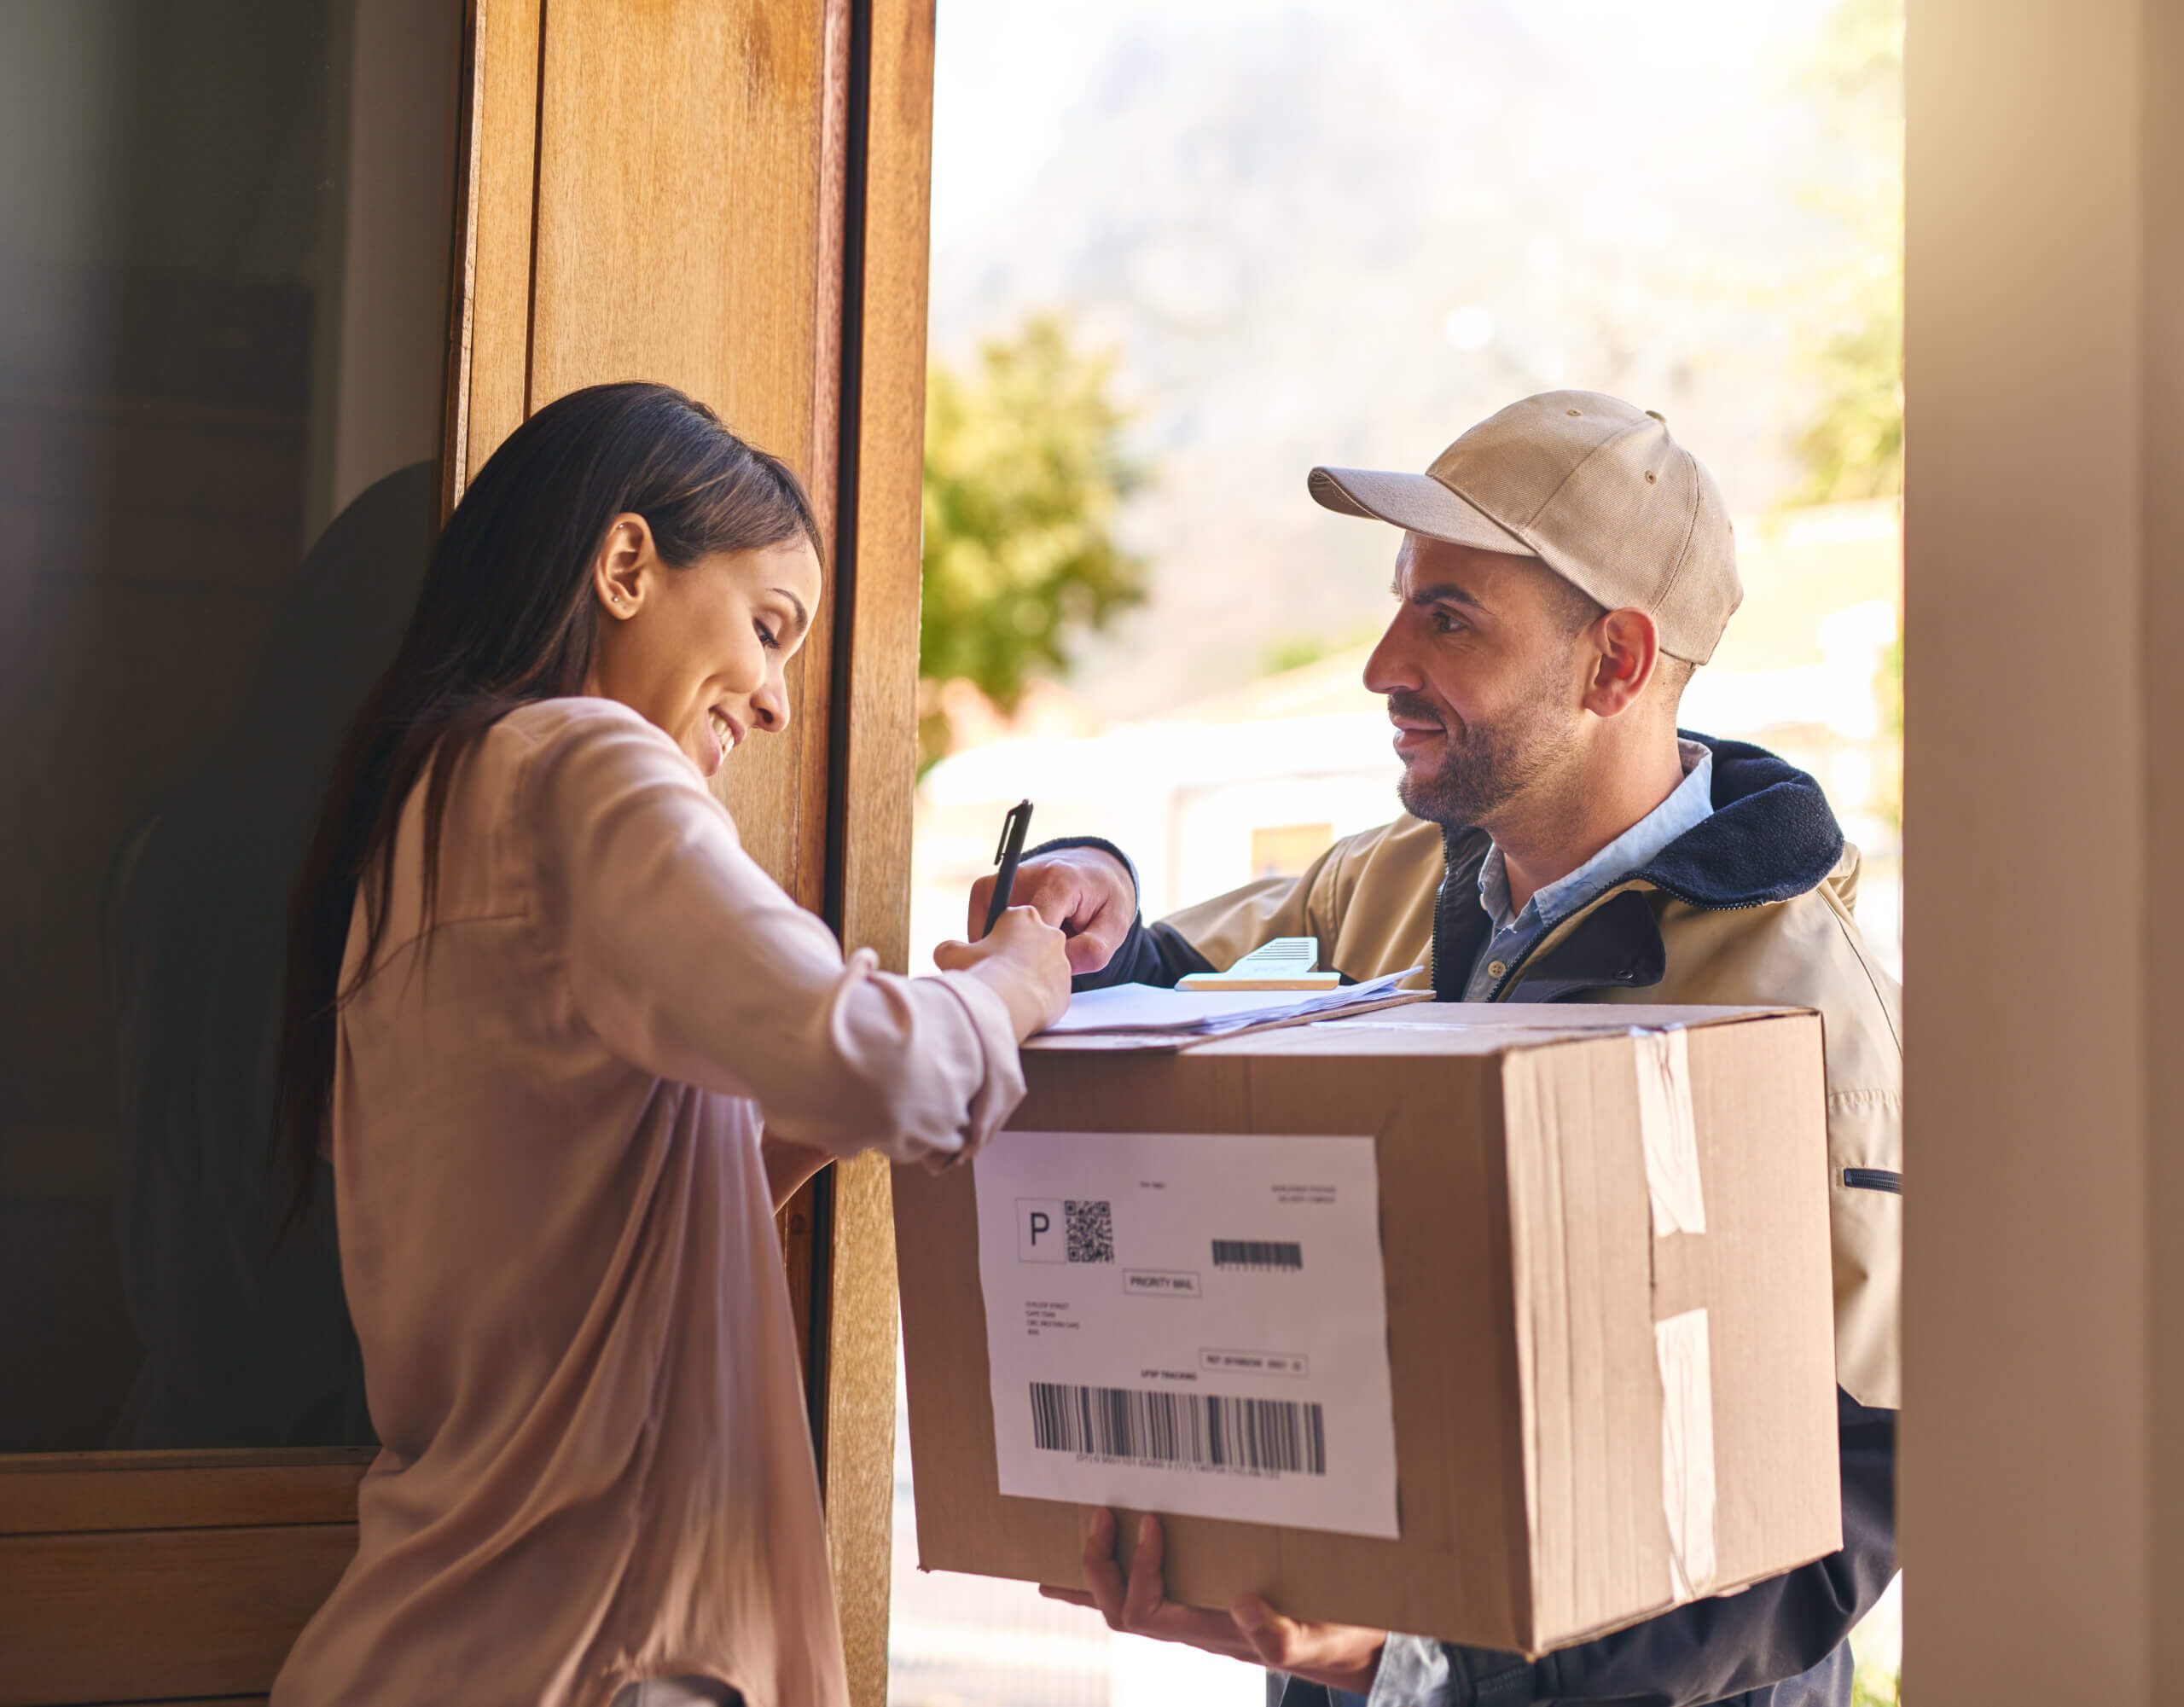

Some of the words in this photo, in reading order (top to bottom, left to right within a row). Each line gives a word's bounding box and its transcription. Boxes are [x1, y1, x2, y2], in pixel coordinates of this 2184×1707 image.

[1031, 1212, 1049, 1245] P
[1130, 1275, 1170, 1289] PRIORITY
[1173, 1279, 1194, 1290] MAIL
